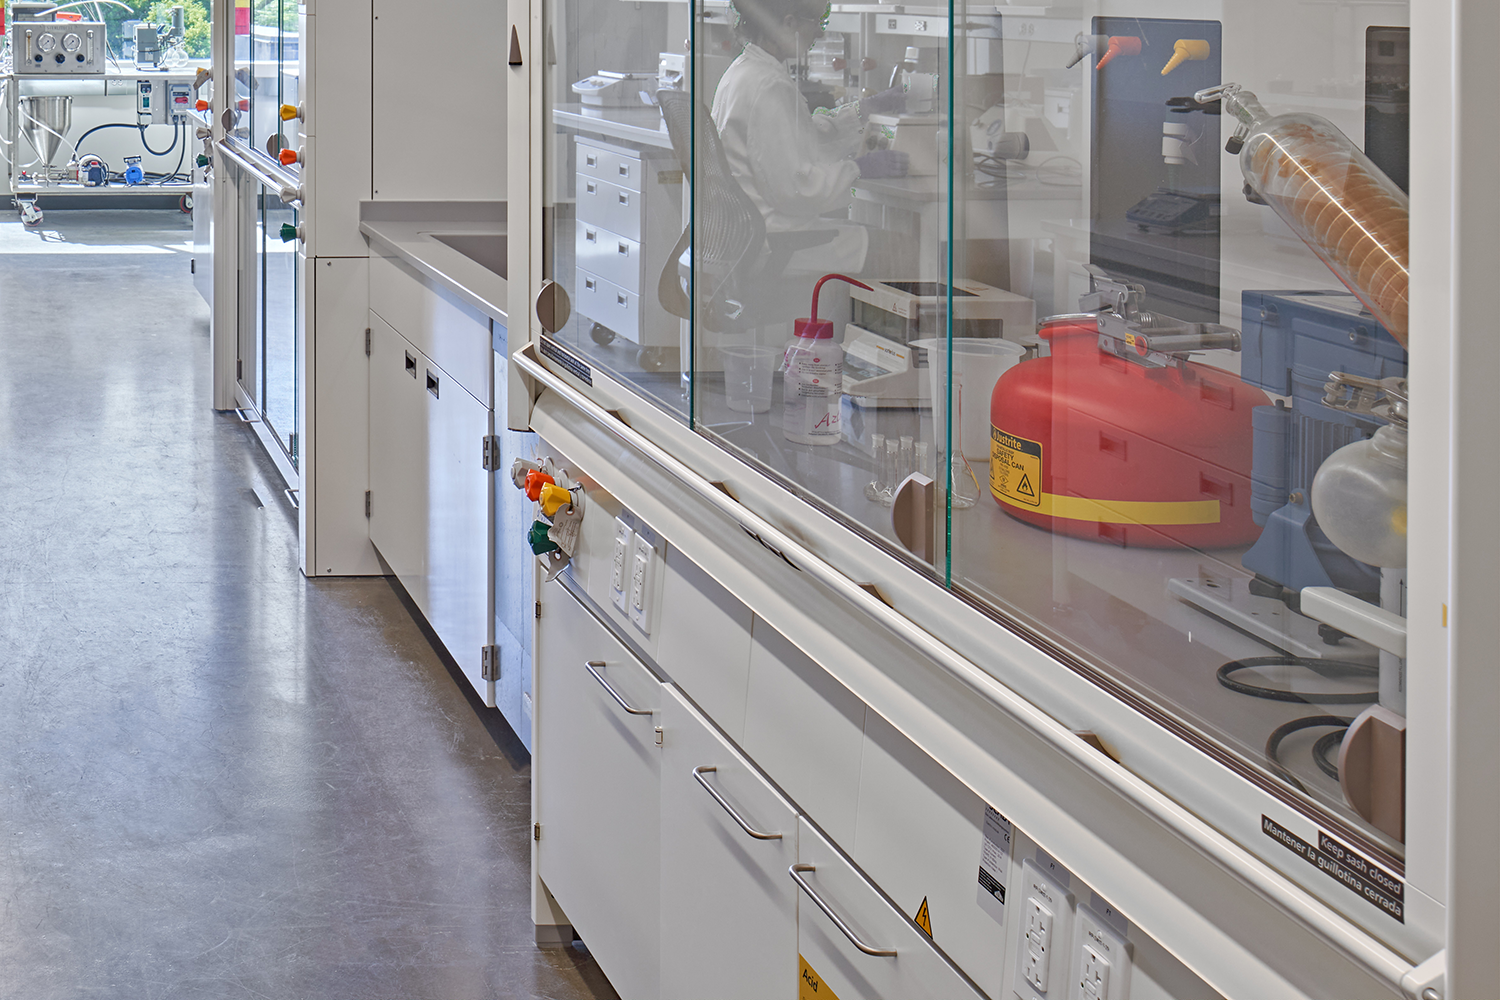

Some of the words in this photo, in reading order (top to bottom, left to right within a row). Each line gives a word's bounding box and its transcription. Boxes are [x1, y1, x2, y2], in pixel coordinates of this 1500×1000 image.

[997, 430, 1022, 450] Justrite
[1011, 461, 1024, 471] CAN
[1049, 862, 1056, 870] F1
[1263, 819, 1306, 854] Mantener
[1307, 847, 1316, 861] la
[1318, 856, 1362, 891] guillotina
[1364, 886, 1402, 917] cerrada
[1320, 835, 1344, 860] Keep
[1346, 853, 1367, 874] sash
[1369, 868, 1401, 895] closed
[1105, 908, 1112, 916] F1
[802, 968, 819, 993] Acid
